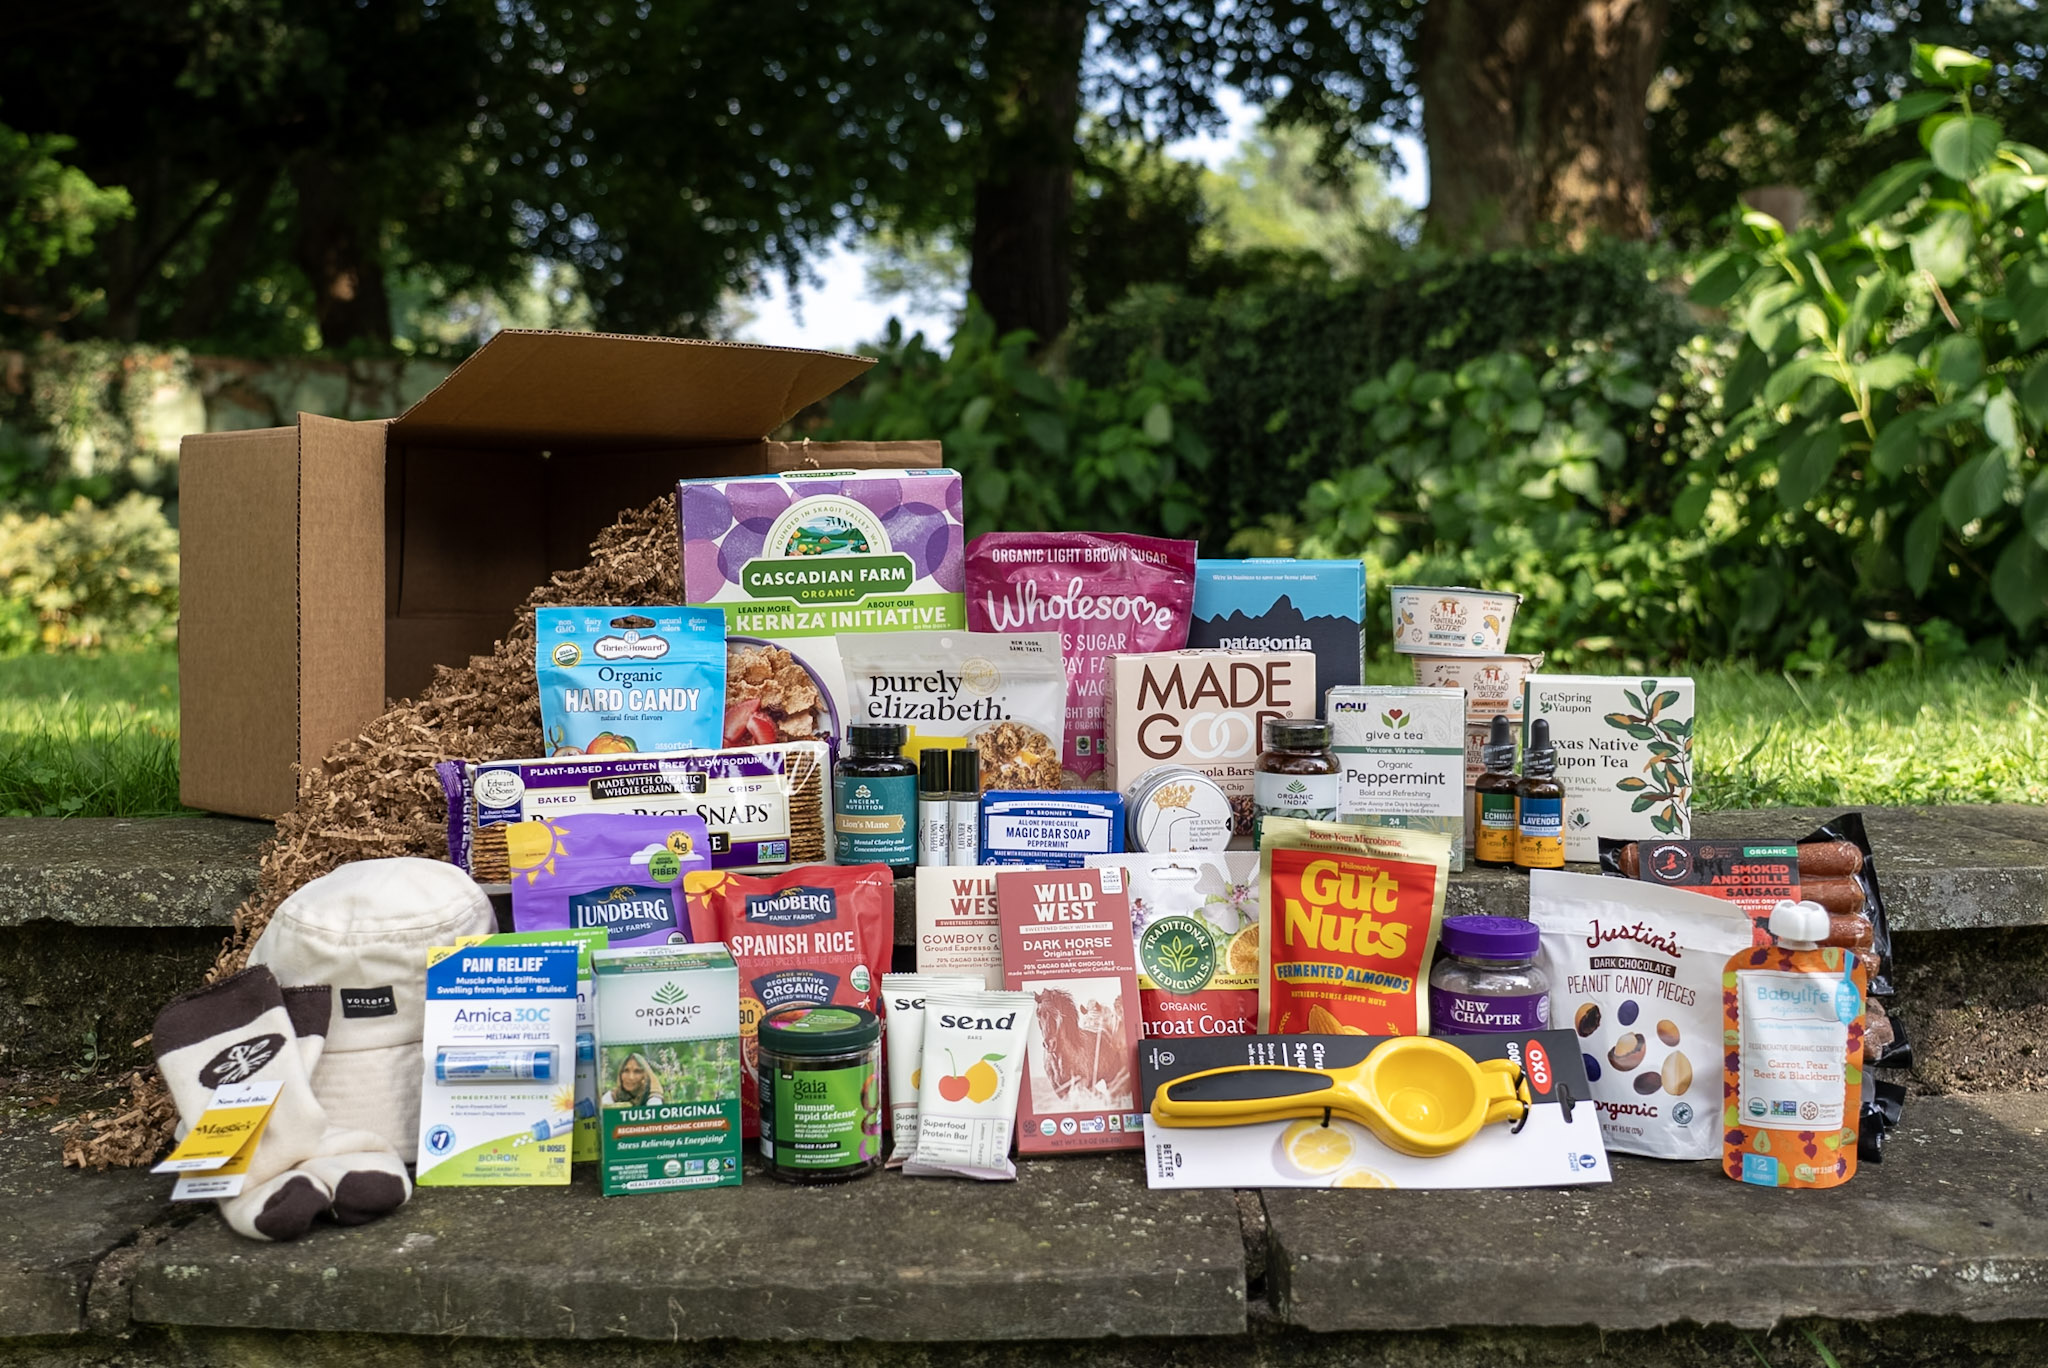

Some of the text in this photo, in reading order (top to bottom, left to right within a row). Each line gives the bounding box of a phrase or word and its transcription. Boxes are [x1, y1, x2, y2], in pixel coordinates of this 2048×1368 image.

[813, 506, 842, 515] SKAGIT
[992, 548, 1168, 564] ORGANIC LIGHT BROWN SUGAR
[751, 568, 907, 586] CASCADIAN FARM
[801, 588, 856, 600] ORGANIC
[738, 605, 791, 614] LEARN MORE
[867, 599, 915, 609] ABOUT OUR
[987, 576, 1172, 632] Wholesome
[832, 606, 946, 629] INITIATIVE
[1077, 633, 1127, 650] SUGAR
[1219, 635, 1312, 653] patagonia
[598, 667, 662, 688] Organic
[869, 669, 963, 700] purely
[1137, 662, 1291, 711] MADE
[565, 688, 700, 713] HARD CANDY
[1552, 703, 1592, 714] Yaupon
[1366, 731, 1423, 741] give tea
[655, 740, 693, 750] assorted
[1588, 737, 1639, 751] Native
[530, 756, 762, 776] PLANT-BASED GLUTEN LOW SODIUM
[1377, 760, 1413, 771] Organic
[1600, 755, 1628, 768] Tea
[1226, 767, 1254, 777] Bars
[1346, 769, 1446, 788] Peppermint
[597, 775, 700, 789] MADE WITH ORGANIC
[1575, 777, 1597, 785] PACK
[605, 784, 673, 797] WHOLE GRAIN
[728, 785, 762, 793] CRISP
[1359, 789, 1376, 797] Bold
[1393, 790, 1431, 799] Refreshing
[538, 796, 577, 804] BAKED
[696, 804, 769, 825] SNAPS
[1523, 816, 1560, 825] LAVENDER
[842, 820, 890, 828] Lion's Mane
[1389, 817, 1400, 826] 24
[930, 820, 939, 852] PEPPERMINT
[958, 822, 966, 850] LAVENDER
[1006, 827, 1091, 840] MAGIC BAR SOAP
[874, 839, 894, 847] Clarity
[1027, 840, 1069, 848] PEPPERMINT
[1354, 834, 1401, 847] Microbiome
[652, 868, 678, 877] FIBER
[1731, 864, 1790, 875] SMOKED
[1711, 874, 1790, 885] ANDOUILLE
[1033, 882, 1093, 903] WILD
[1301, 859, 1399, 914] Gut
[1726, 887, 1790, 897] SAUSAGE
[751, 894, 831, 918] LUNDBERG
[1032, 901, 1097, 922] WEST
[577, 898, 669, 929] LUNDBERG
[625, 923, 651, 933] FARMS
[1285, 898, 1409, 959] Nuts
[922, 934, 983, 944] COWBOY
[1145, 920, 1210, 951] TRADITIONAL
[1586, 919, 1681, 959] Justin's
[731, 931, 855, 957] SPANISH RICE
[1023, 937, 1112, 951] DARK HORSE
[1043, 950, 1074, 958] Original
[462, 958, 493, 973] PAIN
[1594, 958, 1671, 976] DARK CHOCOLATE
[456, 977, 485, 985] Muscle
[514, 976, 550, 984] Stiffness
[766, 976, 824, 987] REGENERATIVE
[1149, 963, 1209, 990] MEDICINALS
[1276, 963, 1411, 992] FERMENTED ALMONDS
[437, 986, 527, 995] Swelling from Injuries
[762, 983, 829, 1000] ORGANIC
[1567, 974, 1696, 1006] PEANUT CANDY PIECES
[1757, 985, 1830, 1004] Babylife
[766, 995, 793, 1005] CERTIFIED
[1160, 1002, 1208, 1011] ORGANIC
[1344, 994, 1387, 1007] SUPER NUTS
[1454, 998, 1490, 1013] NEW
[454, 1007, 551, 1023] Arnica 30C
[635, 1005, 701, 1018] ORGANIC
[1454, 1010, 1521, 1025] CHAPTER
[649, 1016, 690, 1027] INDIA
[939, 1012, 1016, 1030] send
[1200, 1015, 1246, 1035] Coat
[1529, 1049, 1548, 1084] OXO
[1806, 1060, 1829, 1070] Pear
[1754, 1069, 1841, 1083] Beet Blackberry
[793, 1079, 827, 1100] gaia
[620, 1106, 723, 1121] TULSI ORIGINAL
[794, 1103, 835, 1111] immune
[794, 1112, 820, 1122] rapid
[617, 1125, 662, 1134] REGENERATIVE
[664, 1123, 692, 1131] ORGANIC
[924, 1119, 966, 1130] Superfood
[922, 1130, 968, 1141] Protein Bar
[617, 1138, 676, 1150] Stress Relieving
[1163, 1144, 1174, 1178] BETTER
